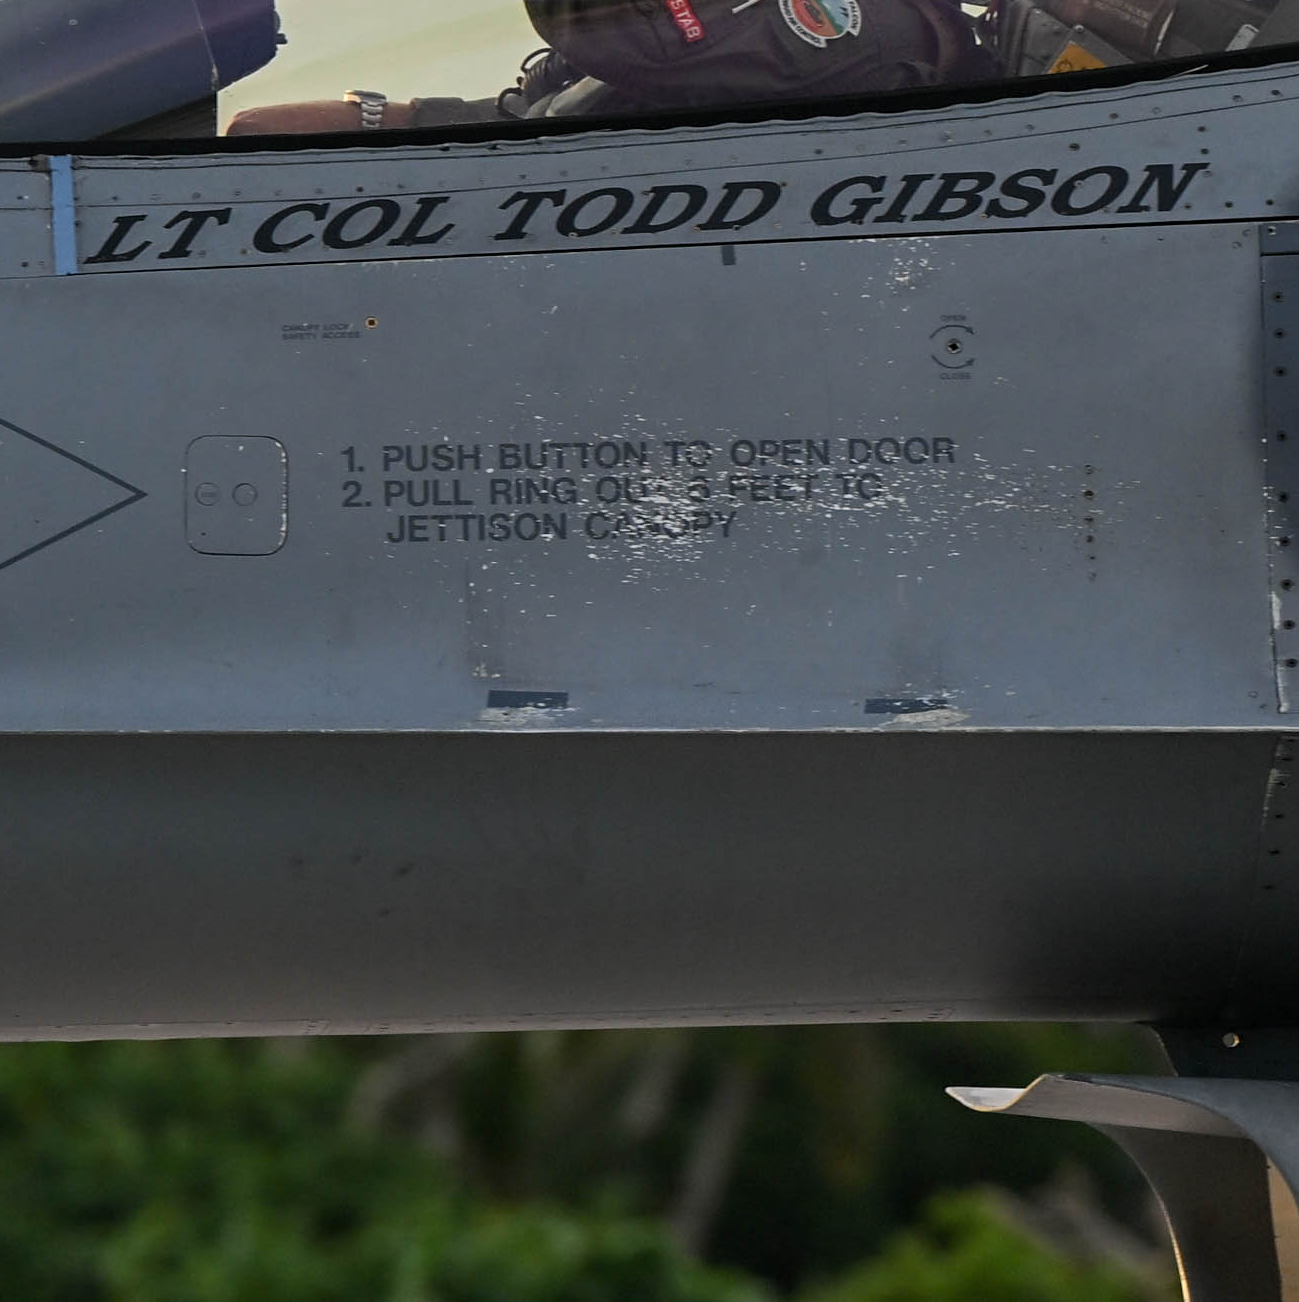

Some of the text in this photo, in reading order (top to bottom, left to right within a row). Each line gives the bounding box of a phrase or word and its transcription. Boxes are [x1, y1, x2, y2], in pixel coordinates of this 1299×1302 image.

[84, 162, 1211, 265] LT COL TODD GIBSON
[341, 436, 956, 473] 1. PUSH BUTTON TO OPEN DOOR
[342, 480, 372, 508] 2.
[384, 480, 474, 507] PULL
[489, 477, 578, 506] RING
[730, 473, 819, 502] FEET
[835, 472, 883, 501] TO
[387, 510, 738, 543] JETTISON CANOPY
